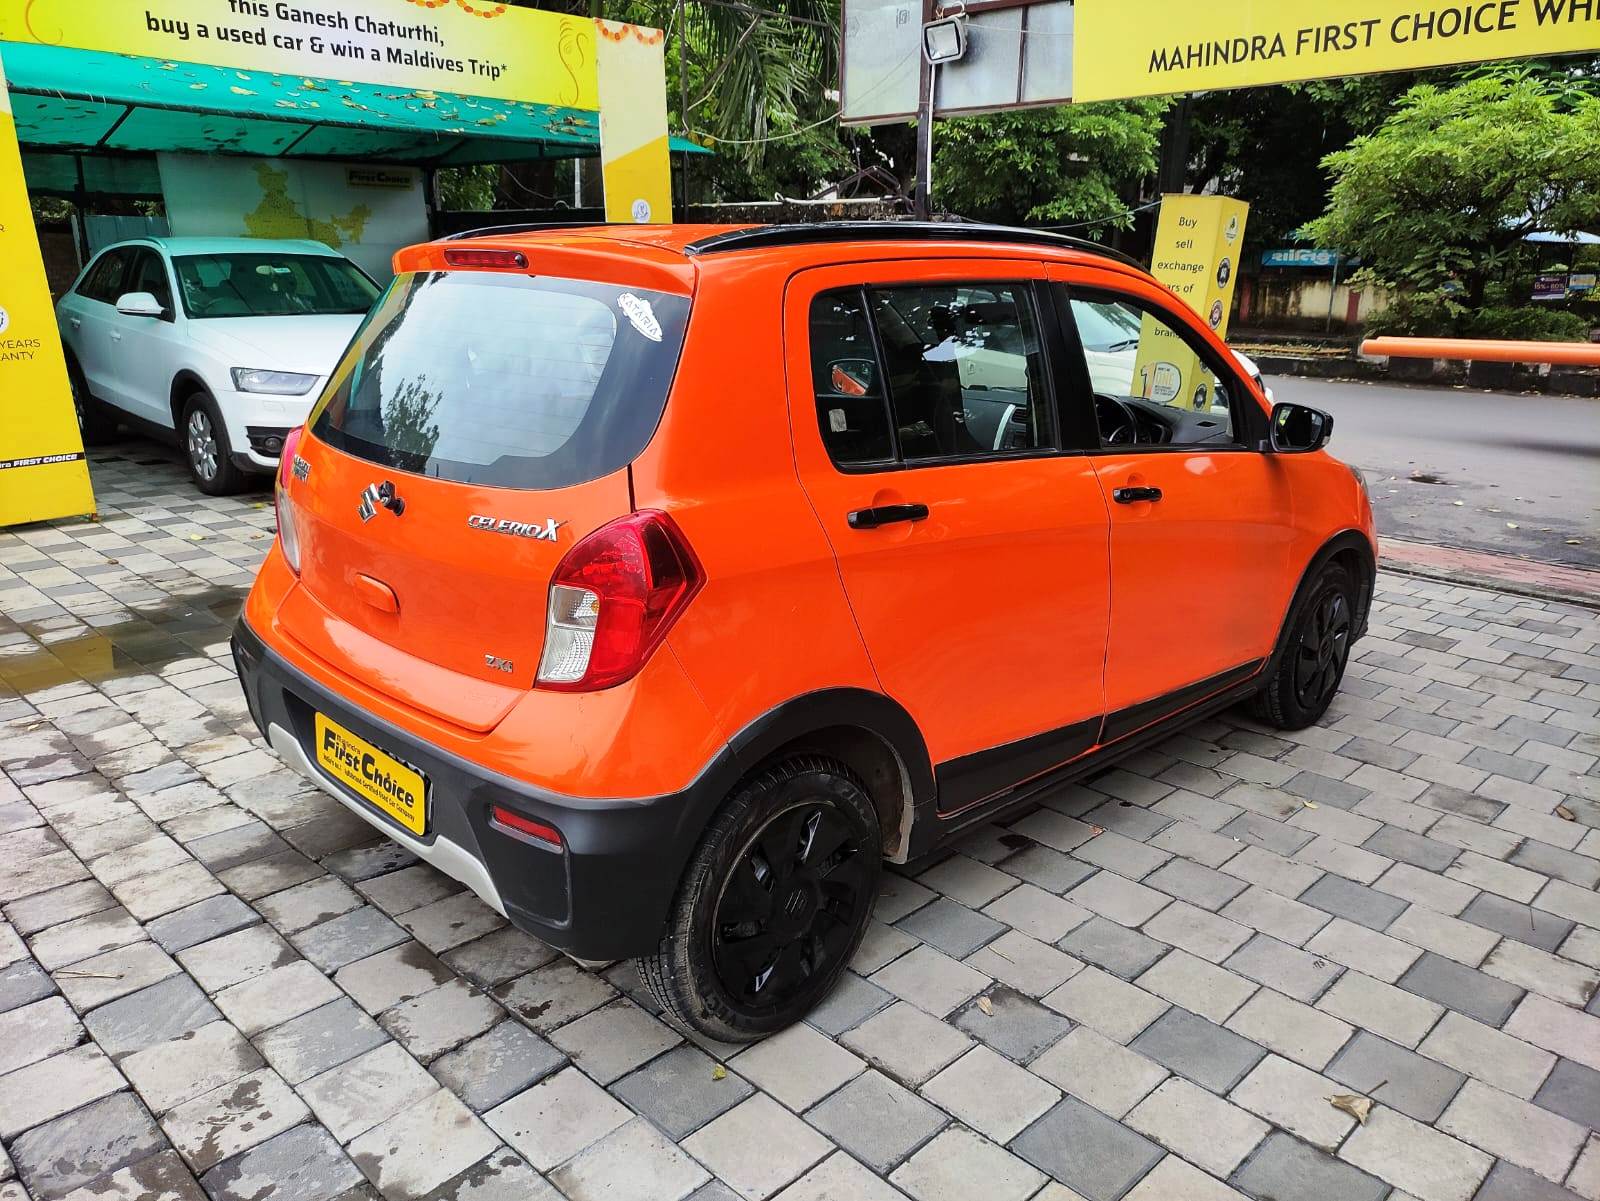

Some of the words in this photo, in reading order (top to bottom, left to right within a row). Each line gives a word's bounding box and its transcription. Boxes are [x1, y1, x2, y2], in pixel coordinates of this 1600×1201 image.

[228, 0, 269, 17] this
[275, 3, 349, 30] Ganesh
[354, 16, 445, 47] Chaturthi,
[145, 11, 190, 40] buy
[196, 23, 210, 39] a
[216, 27, 267, 46] used
[273, 34, 303, 51] car
[310, 36, 325, 53] &
[331, 41, 365, 60] win
[370, 49, 381, 62] a
[386, 47, 464, 73] Maldives
[1148, 32, 1287, 73] MAHINDRA
[1295, 19, 1381, 56] FIRST
[1390, 0, 1519, 43] CHOICE
[1532, 0, 1600, 26] WH
[1179, 216, 1198, 229] Buy
[1175, 240, 1193, 249] sell
[1157, 260, 1205, 274] exchange
[1164, 283, 1180, 292] ars
[1183, 284, 1194, 293] of
[13, 457, 42, 467] FIRST
[42, 453, 78, 464] CHOICE
[323, 727, 360, 771] First
[361, 752, 415, 808] Choice
